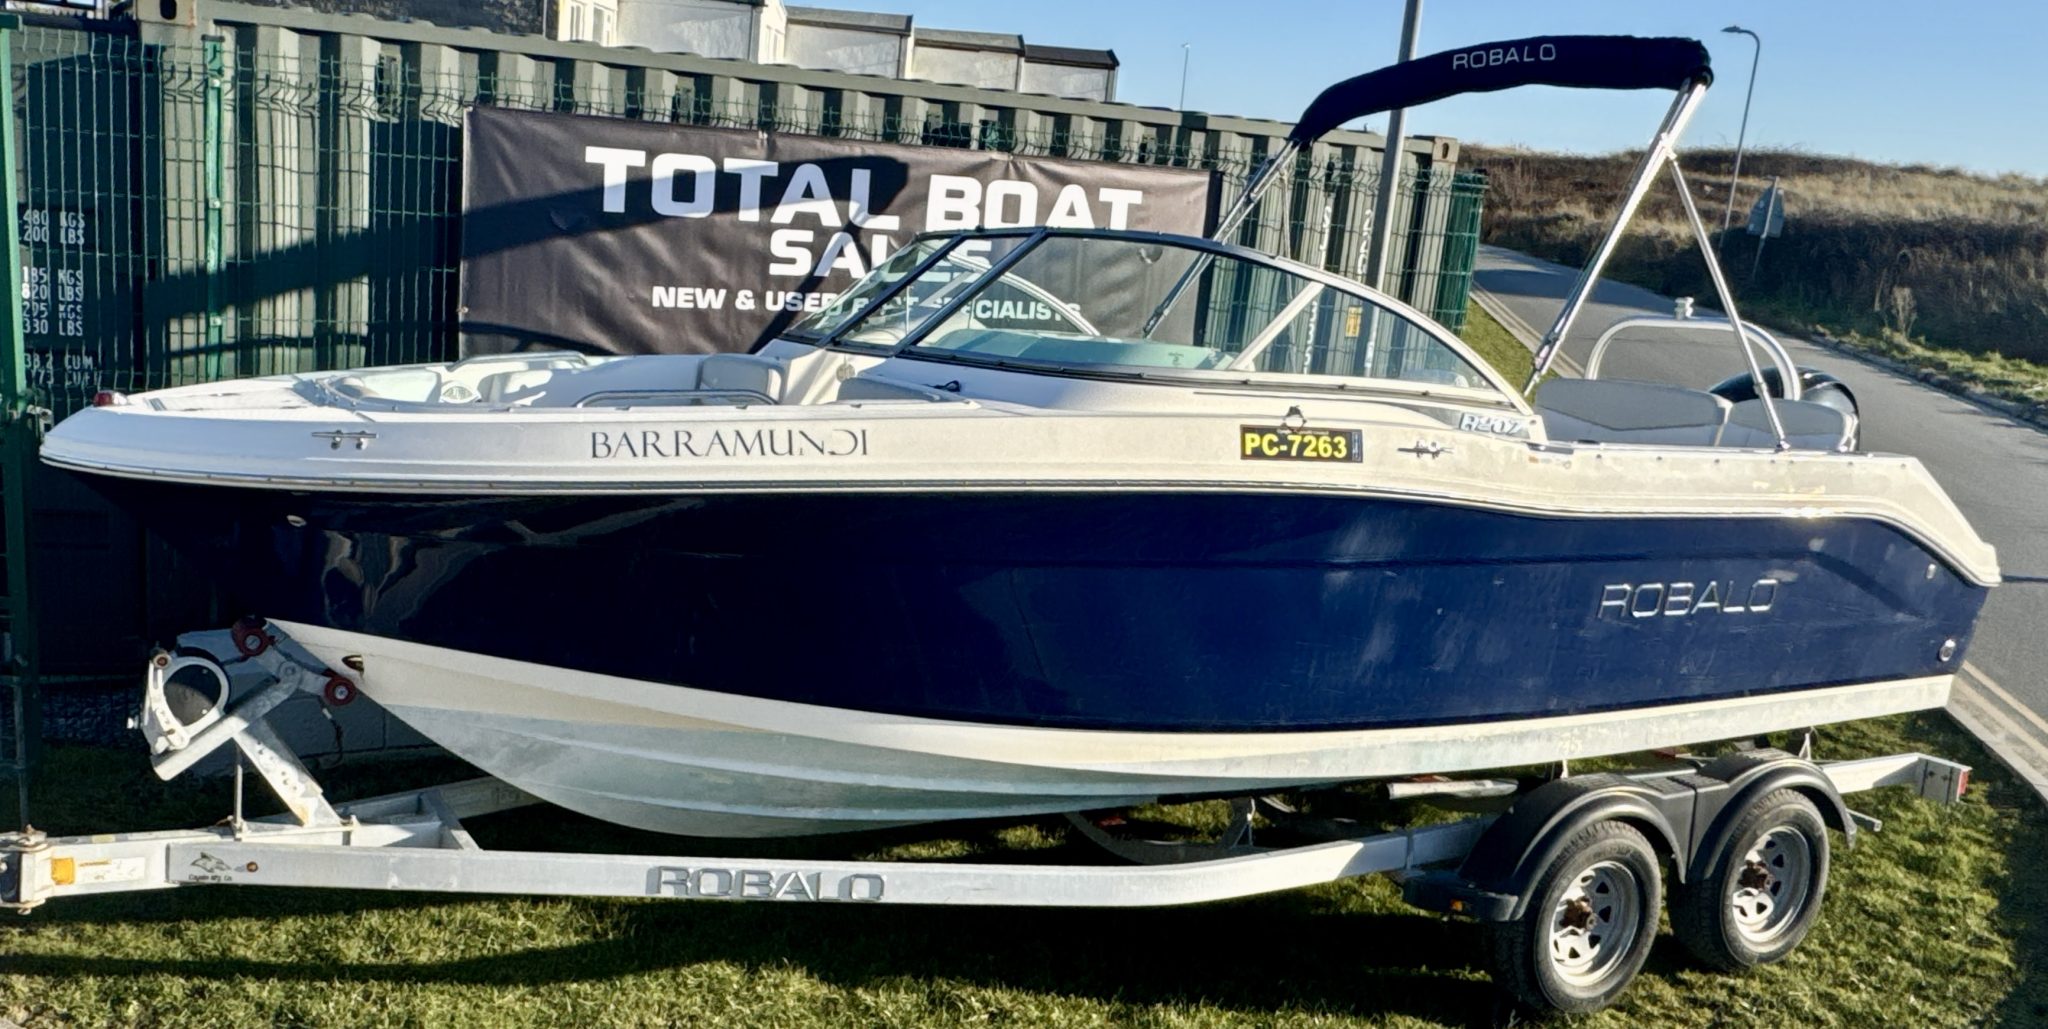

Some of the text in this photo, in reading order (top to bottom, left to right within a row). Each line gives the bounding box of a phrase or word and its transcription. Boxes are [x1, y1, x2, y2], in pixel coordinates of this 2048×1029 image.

[1453, 44, 1556, 70] ROBALO
[585, 146, 1143, 231] TOTAL BOAT
[60, 211, 85, 229] KGS
[60, 228, 85, 245] LBS
[769, 228, 993, 283] SALES
[58, 268, 84, 286] KGS
[58, 284, 84, 301] LBS
[652, 286, 727, 310] NEW
[735, 289, 755, 311] &
[765, 290, 842, 315] USED
[58, 303, 84, 321] KGS
[59, 319, 84, 337] LBS
[591, 429, 867, 459] BARRAMUNDI
[1244, 432, 1347, 458] PC-7263
[1598, 579, 1778, 618] ROBALO
[646, 866, 885, 901] ROBALO
